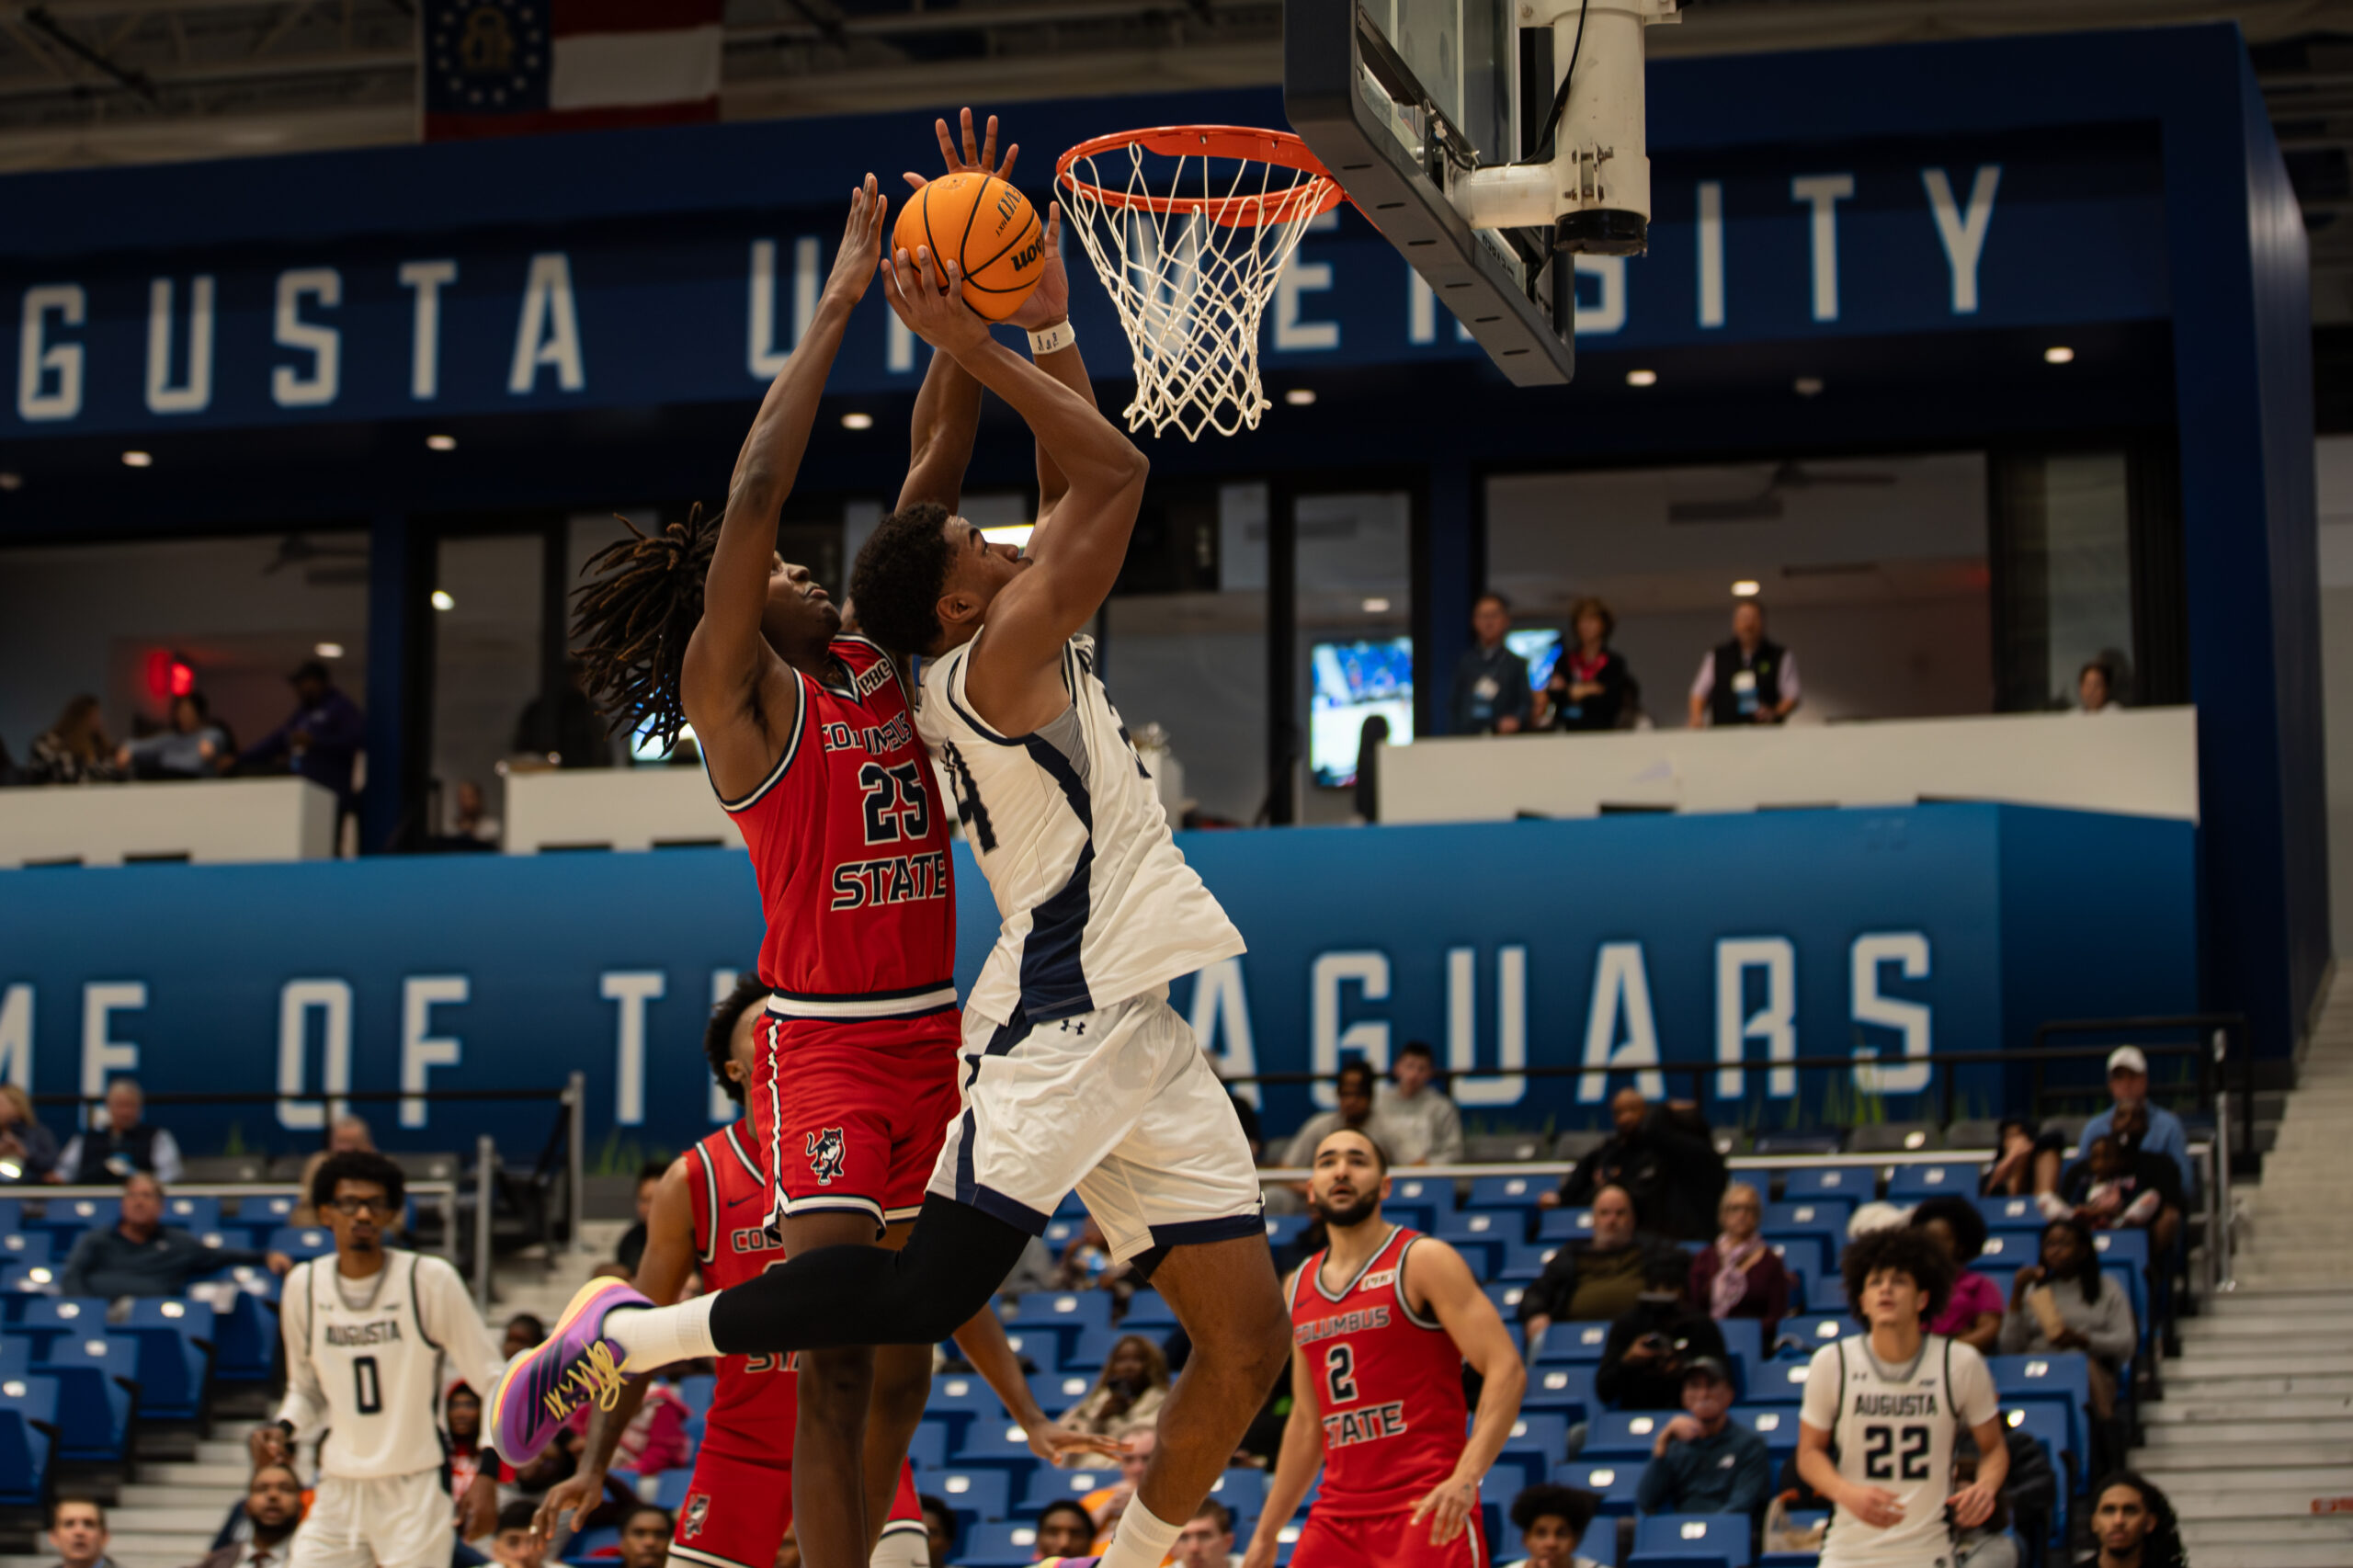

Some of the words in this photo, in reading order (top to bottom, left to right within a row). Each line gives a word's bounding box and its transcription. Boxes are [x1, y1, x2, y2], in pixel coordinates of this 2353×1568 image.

[18, 254, 585, 421] GUSTA
[857, 658, 894, 697] PBC
[858, 759, 929, 846] 25
[830, 850, 947, 912] STATE
[277, 976, 469, 1130] OF
[1189, 932, 1933, 1114] AGUARS
[325, 1320, 403, 1346] AUGUSTA
[1294, 1304, 1391, 1347] COLUMBUS
[353, 1355, 382, 1415] 0
[1325, 1342, 1358, 1404] 2
[1854, 1393, 1938, 1417] AUGUSTA
[1864, 1425, 1929, 1481] 22
